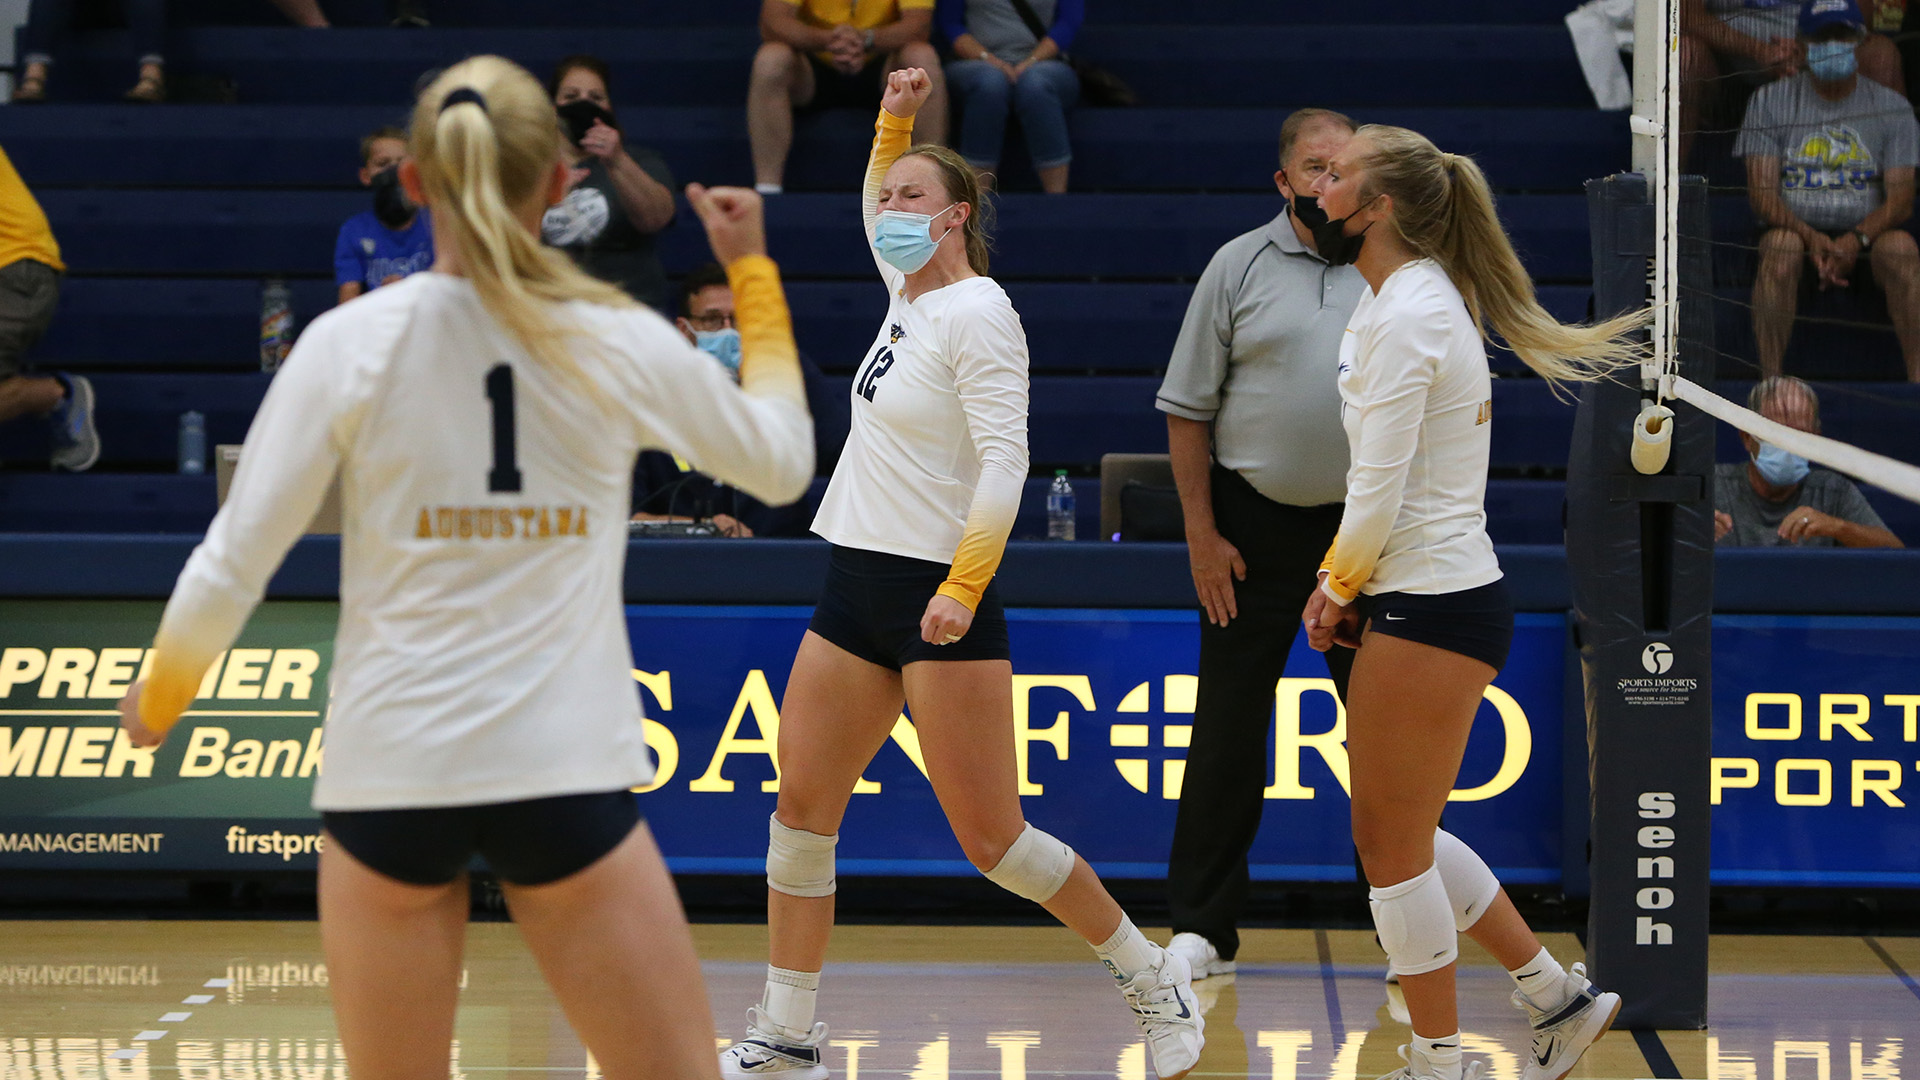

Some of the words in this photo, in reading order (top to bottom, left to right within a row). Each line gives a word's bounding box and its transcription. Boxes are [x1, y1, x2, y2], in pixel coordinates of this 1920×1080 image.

[857, 345, 895, 403] 12
[486, 363, 522, 492] 1
[415, 506, 588, 539] AUGUSTANA
[1617, 679, 1653, 690] SPORTS
[1655, 679, 1697, 690] IMPORTS
[179, 727, 325, 778] Bank
[1710, 757, 1920, 808] POR
[0, 833, 164, 853] MANAGEMENT
[1636, 791, 1676, 946] senoh
